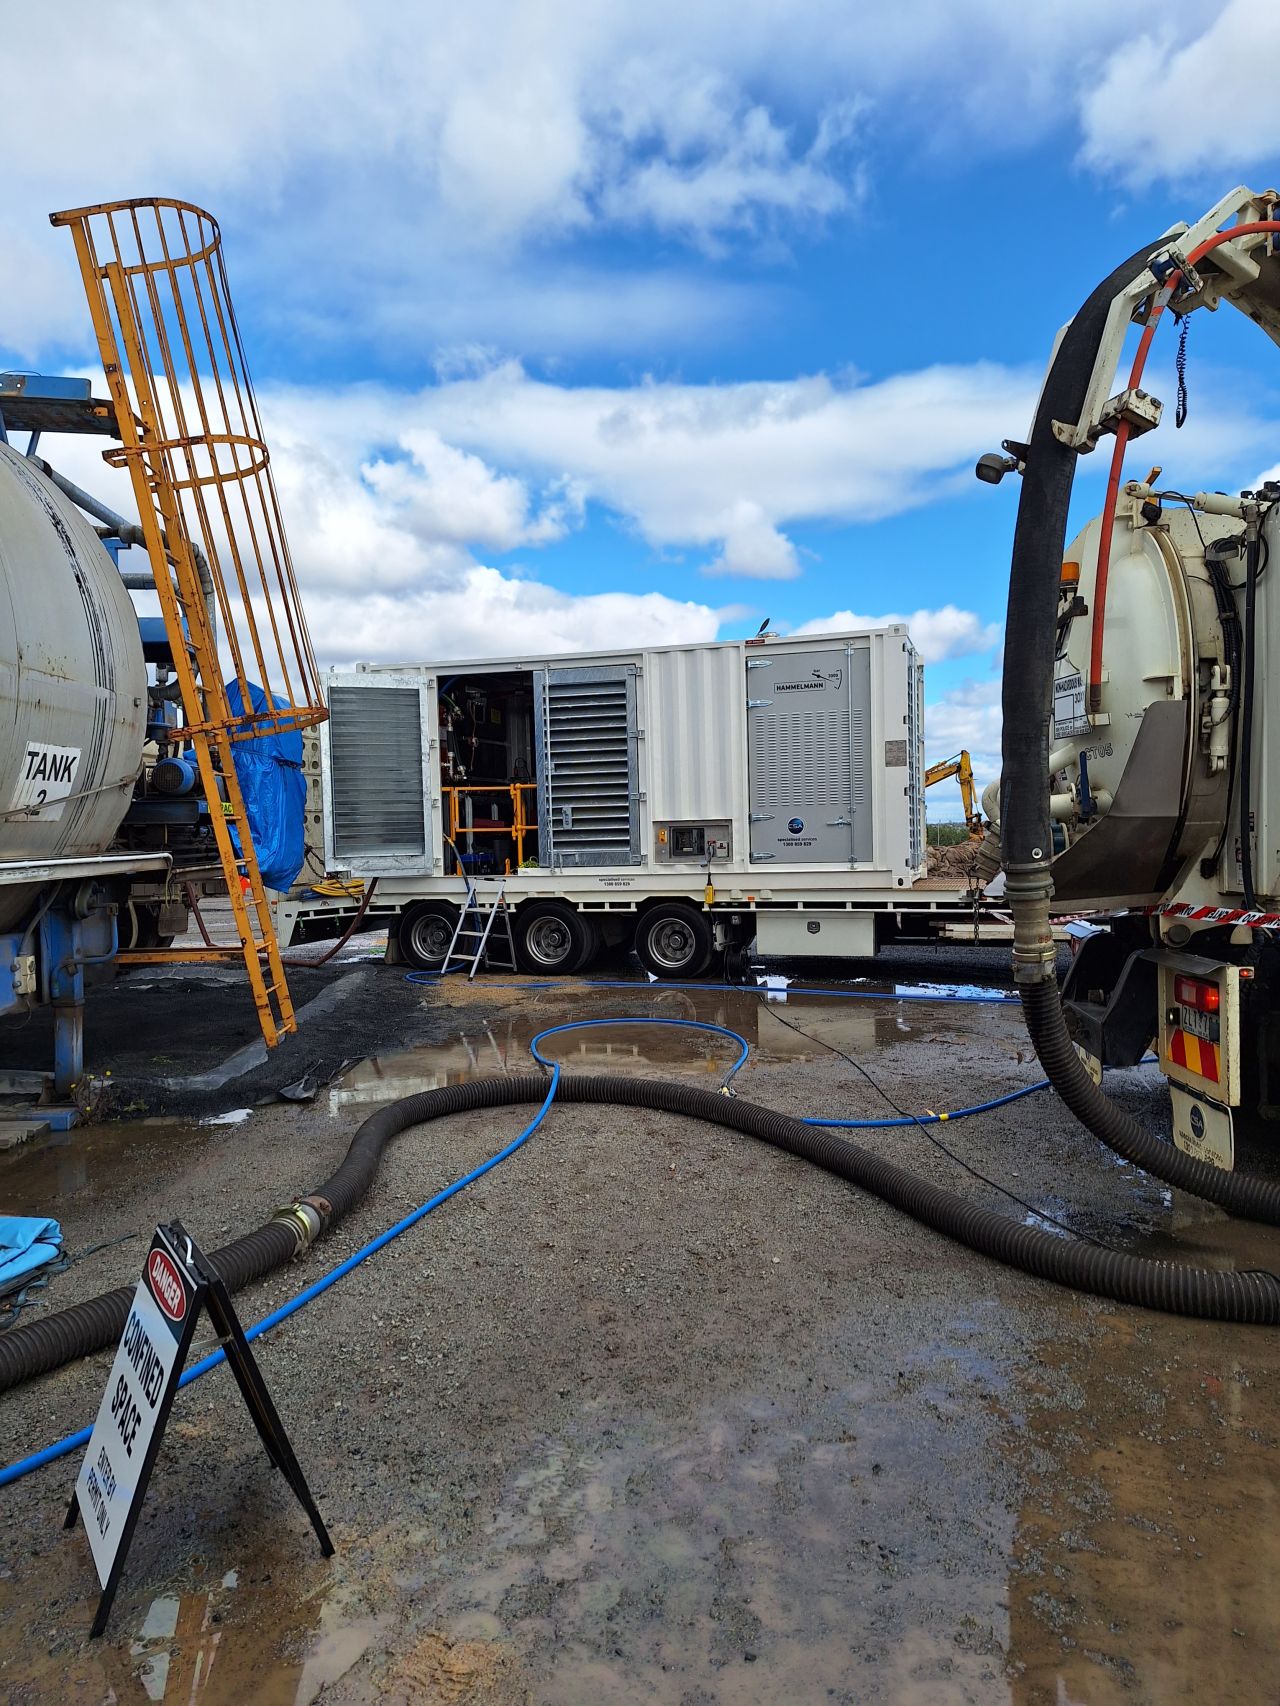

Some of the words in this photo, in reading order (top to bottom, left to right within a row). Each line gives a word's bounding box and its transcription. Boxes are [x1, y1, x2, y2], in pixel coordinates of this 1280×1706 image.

[776, 682, 824, 691] HAMMELMANN
[26, 751, 77, 783] TANK
[30, 789, 47, 815] 2
[152, 1255, 182, 1314] DANGER
[124, 1311, 164, 1409] CONFINED
[112, 1373, 142, 1458] SPACE
[87, 1466, 102, 1513] PERMIT
[97, 1500, 110, 1539] ONLY
[98, 1446, 112, 1490] ENTER
[107, 1474, 117, 1502] BY
